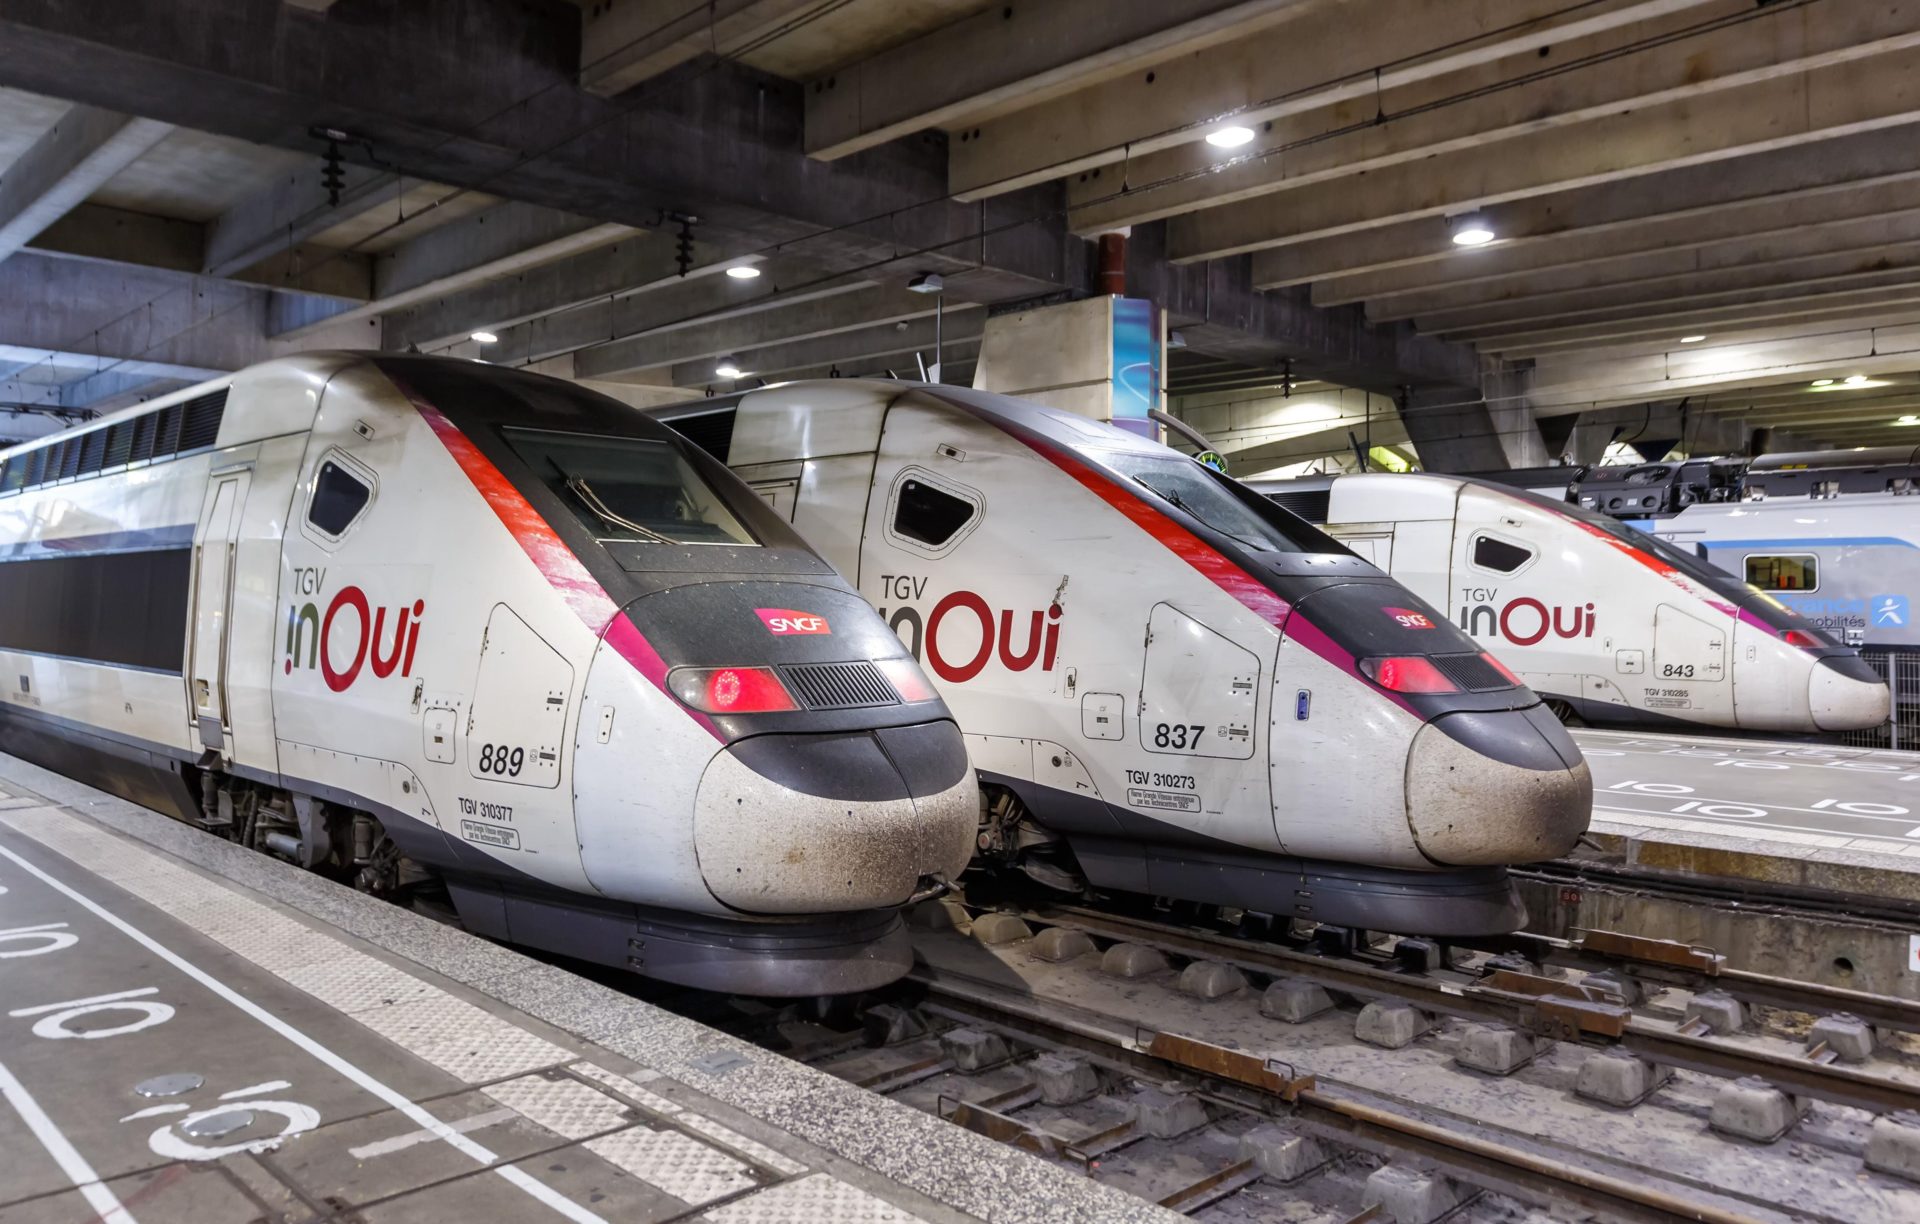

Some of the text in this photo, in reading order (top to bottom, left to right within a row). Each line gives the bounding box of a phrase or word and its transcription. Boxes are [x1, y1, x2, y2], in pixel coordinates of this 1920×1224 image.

[294, 567, 326, 595] TGV
[881, 575, 928, 600] TGV
[1462, 588, 1498, 602] TGV
[769, 617, 823, 632] SNCF
[1663, 663, 1695, 678] 843
[1644, 688, 1660, 696] TGV
[1154, 722, 1206, 750] 837
[479, 743, 525, 777] 889
[1125, 769, 1196, 790] TGV 310273
[458, 797, 513, 822] TGV 310377
